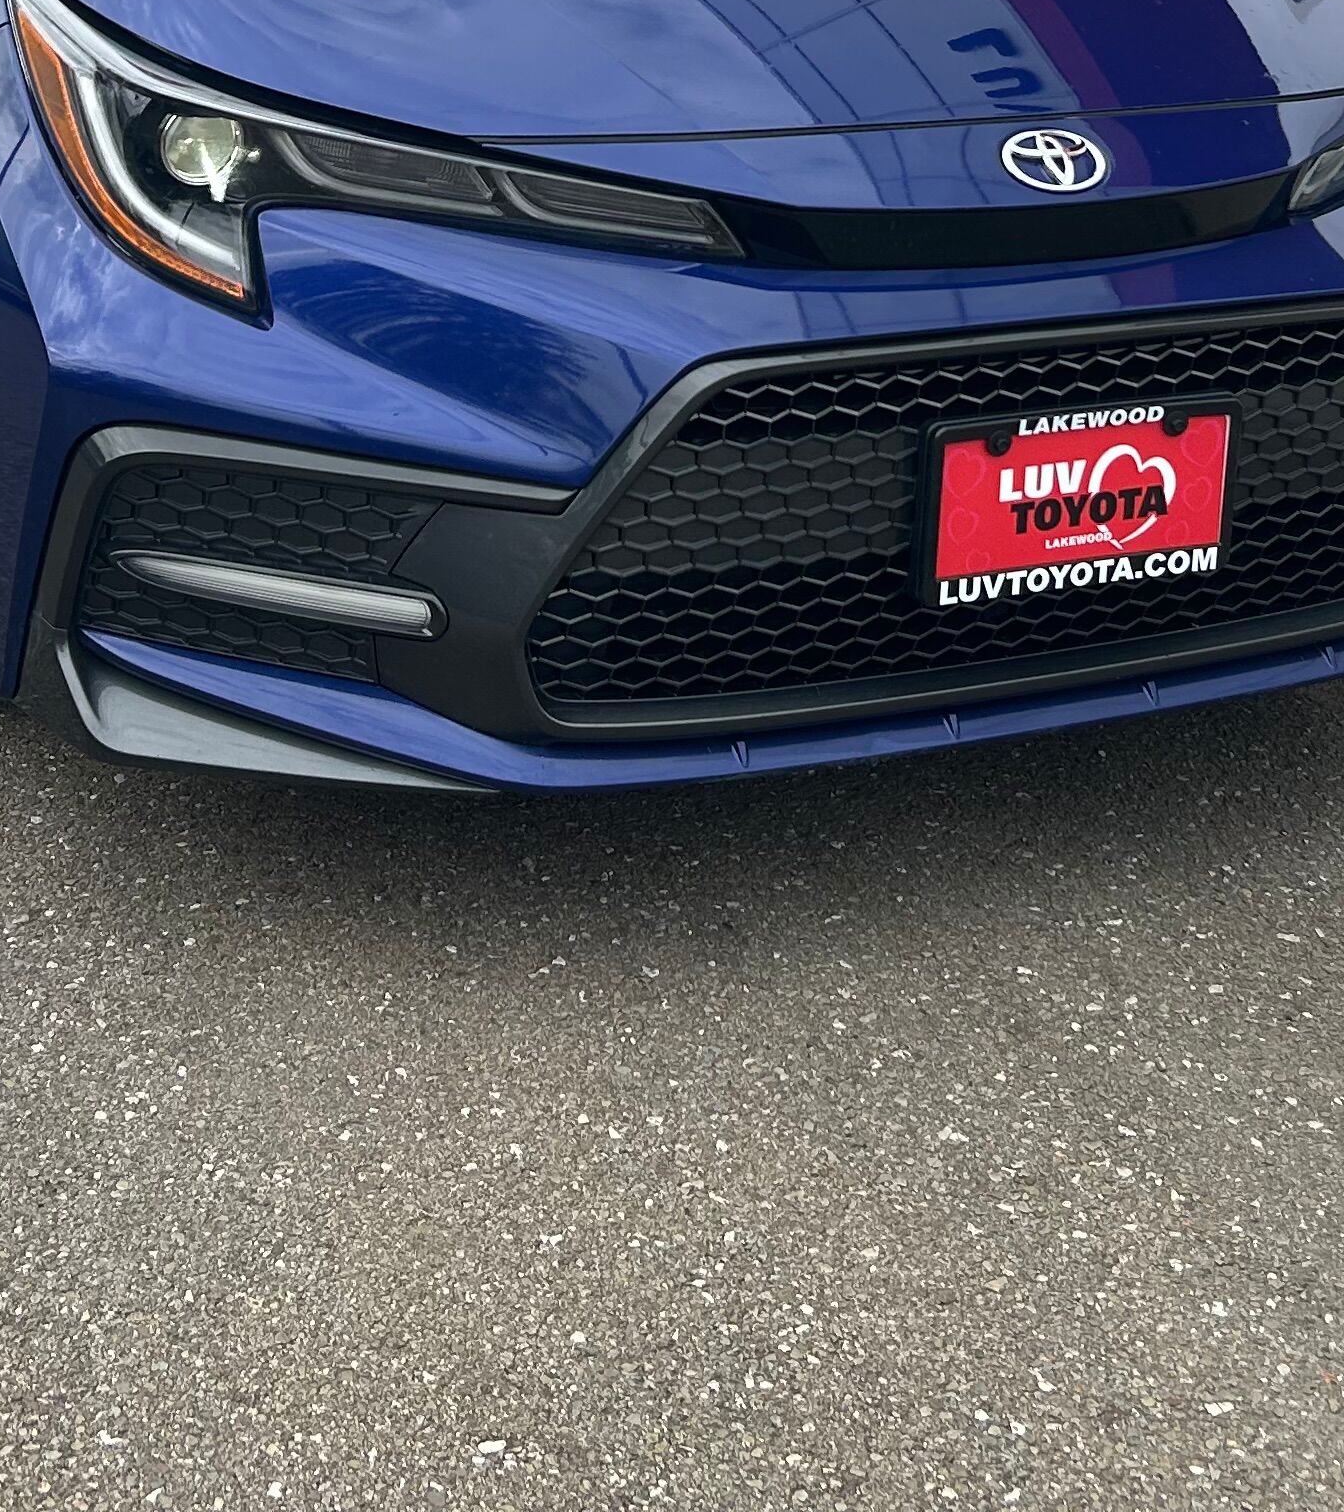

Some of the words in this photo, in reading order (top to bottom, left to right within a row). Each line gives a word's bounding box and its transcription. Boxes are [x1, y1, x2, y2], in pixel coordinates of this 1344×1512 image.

[1018, 405, 1165, 436] LAKEWOOD
[998, 459, 1087, 502] LUV
[1011, 485, 1168, 534] TOYOTA
[1044, 531, 1113, 550] LAKEWOOD
[939, 546, 1218, 606] LUVTOYOTA.COM
